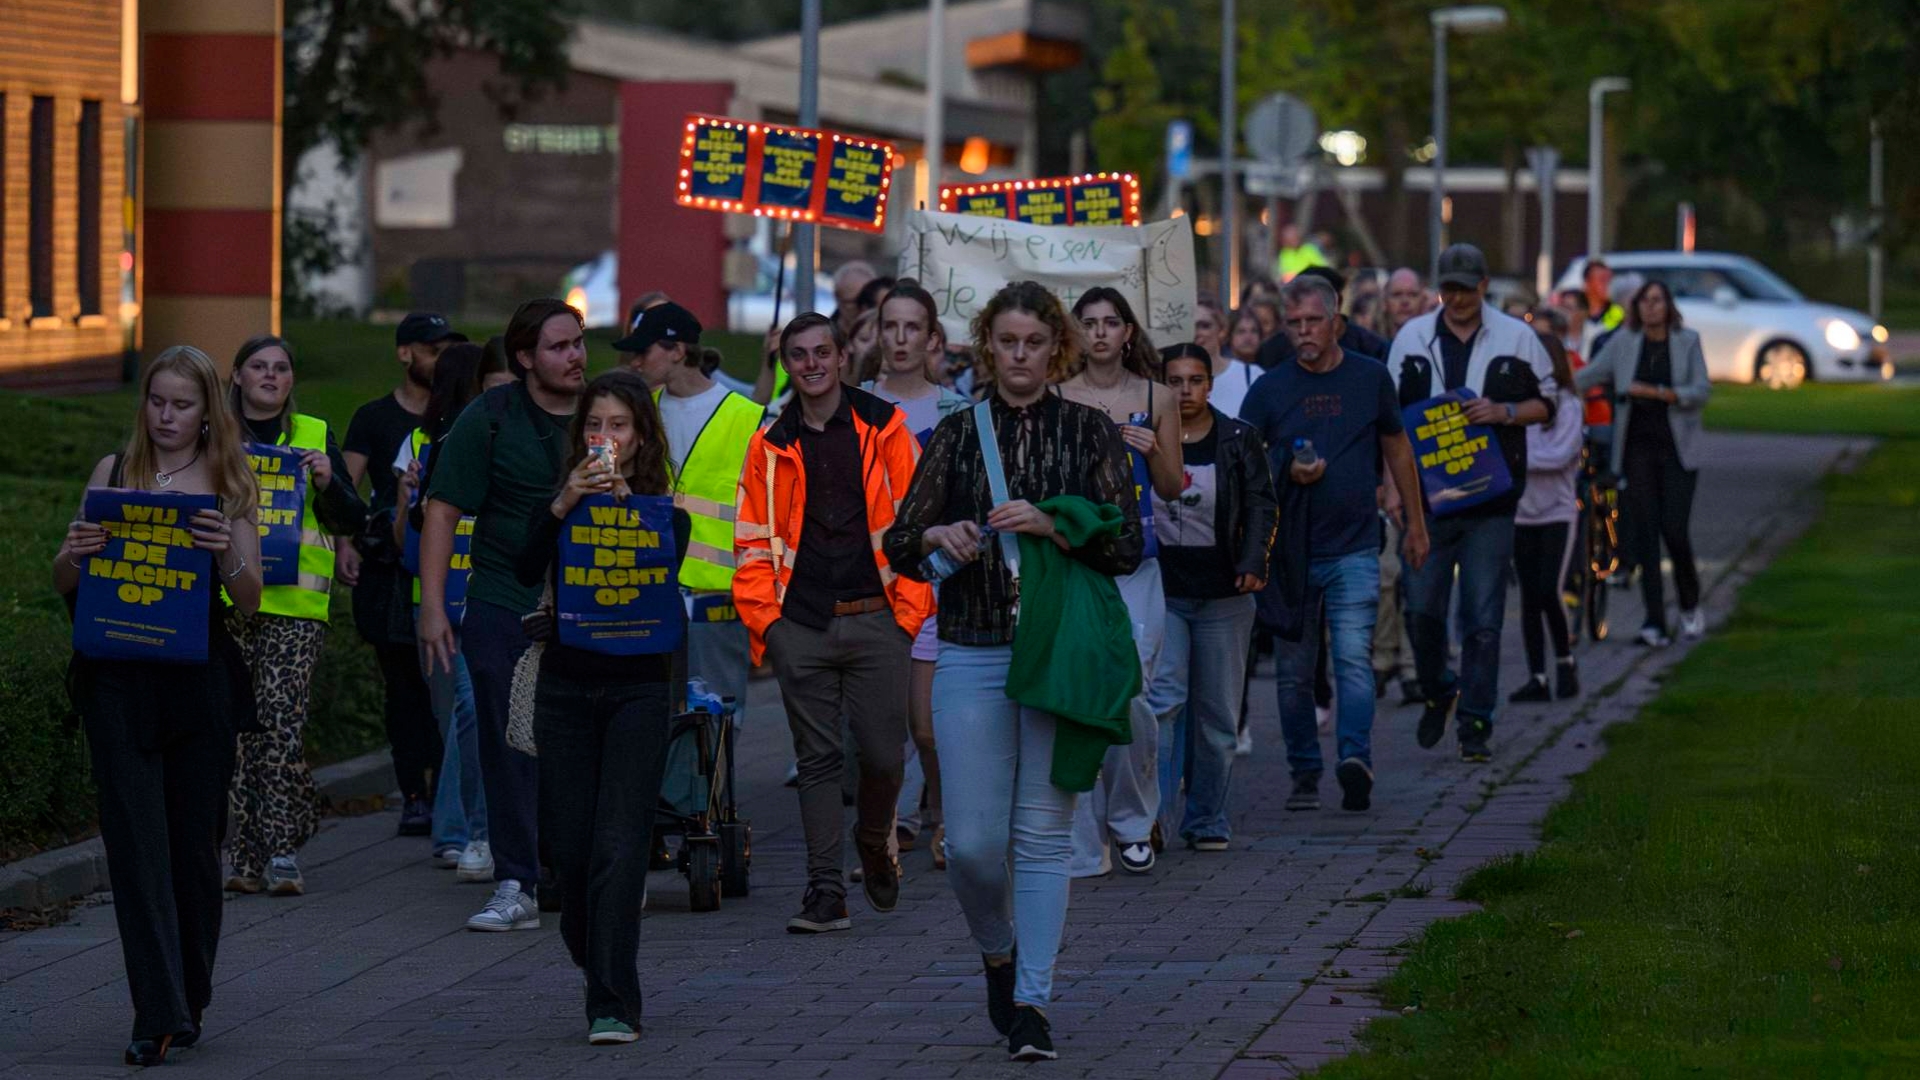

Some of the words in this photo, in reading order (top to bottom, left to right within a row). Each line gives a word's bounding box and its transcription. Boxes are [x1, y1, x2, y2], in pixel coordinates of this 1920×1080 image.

[846, 148, 873, 163] WIJ
[931, 267, 976, 319] de
[1423, 401, 1461, 422] WIJ
[1437, 428, 1467, 449] DE
[1420, 435, 1489, 469] NACHT
[1445, 456, 1475, 475] OP
[122, 503, 178, 525] WIJ
[589, 505, 641, 528] WIJ
[570, 525, 660, 549] EISEN
[123, 541, 168, 566] DE
[594, 547, 637, 568] DE
[88, 557, 197, 591] NACHT
[563, 565, 669, 587] NACHT
[117, 583, 164, 606] OP
[594, 587, 640, 606] OP
